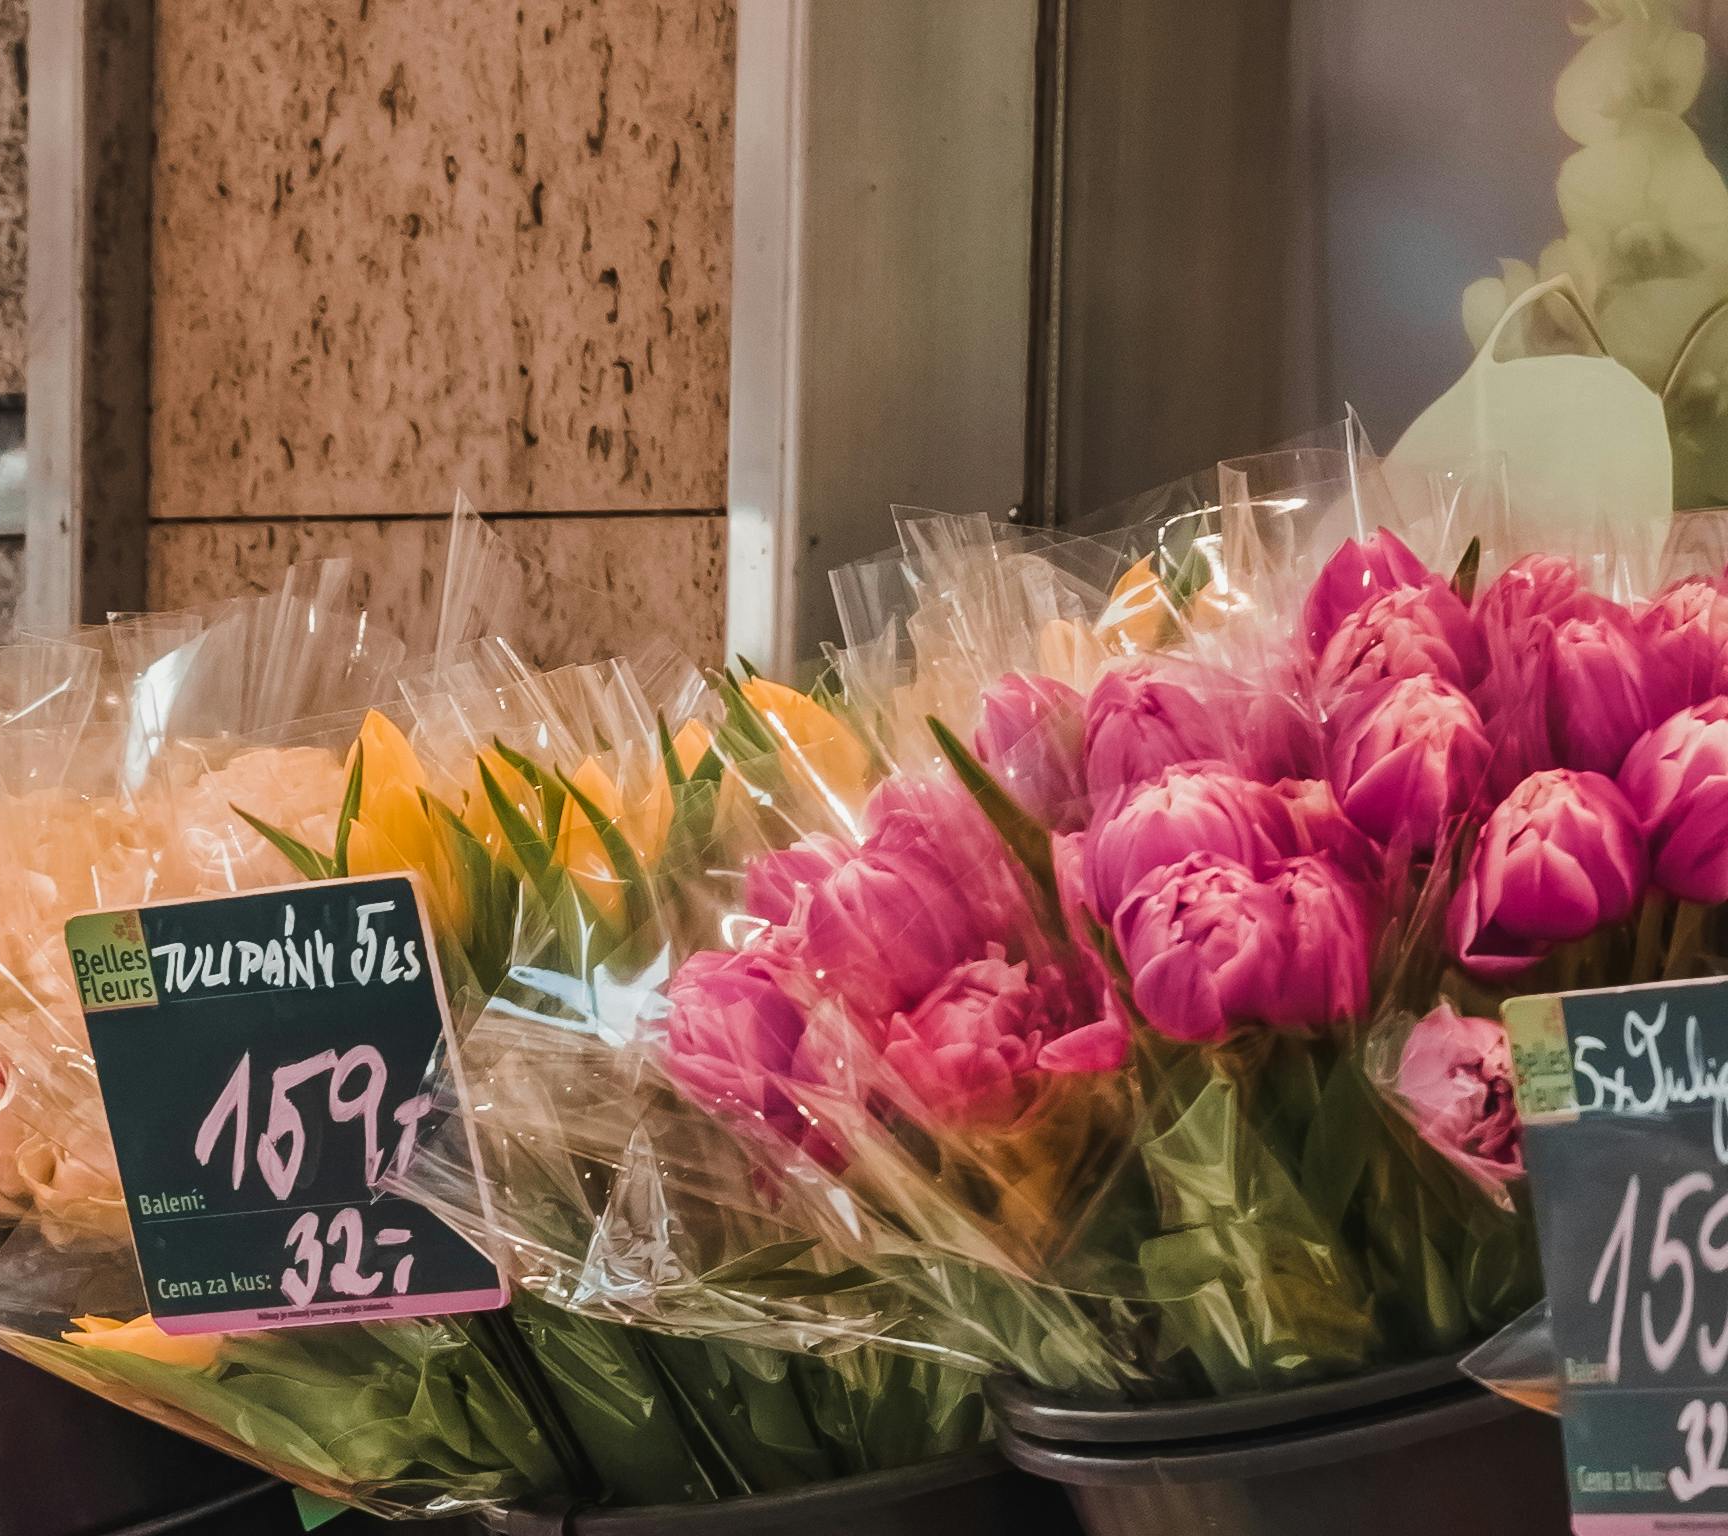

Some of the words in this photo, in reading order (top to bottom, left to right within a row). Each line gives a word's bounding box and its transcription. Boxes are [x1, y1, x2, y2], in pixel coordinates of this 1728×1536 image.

[72, 943, 148, 977] Belles
[78, 974, 154, 1006] Fleurs
[138, 1187, 207, 1216] Balení:
[157, 1278, 203, 1300] Cena
[206, 1278, 229, 1296] za
[230, 1271, 272, 1293] kus:
